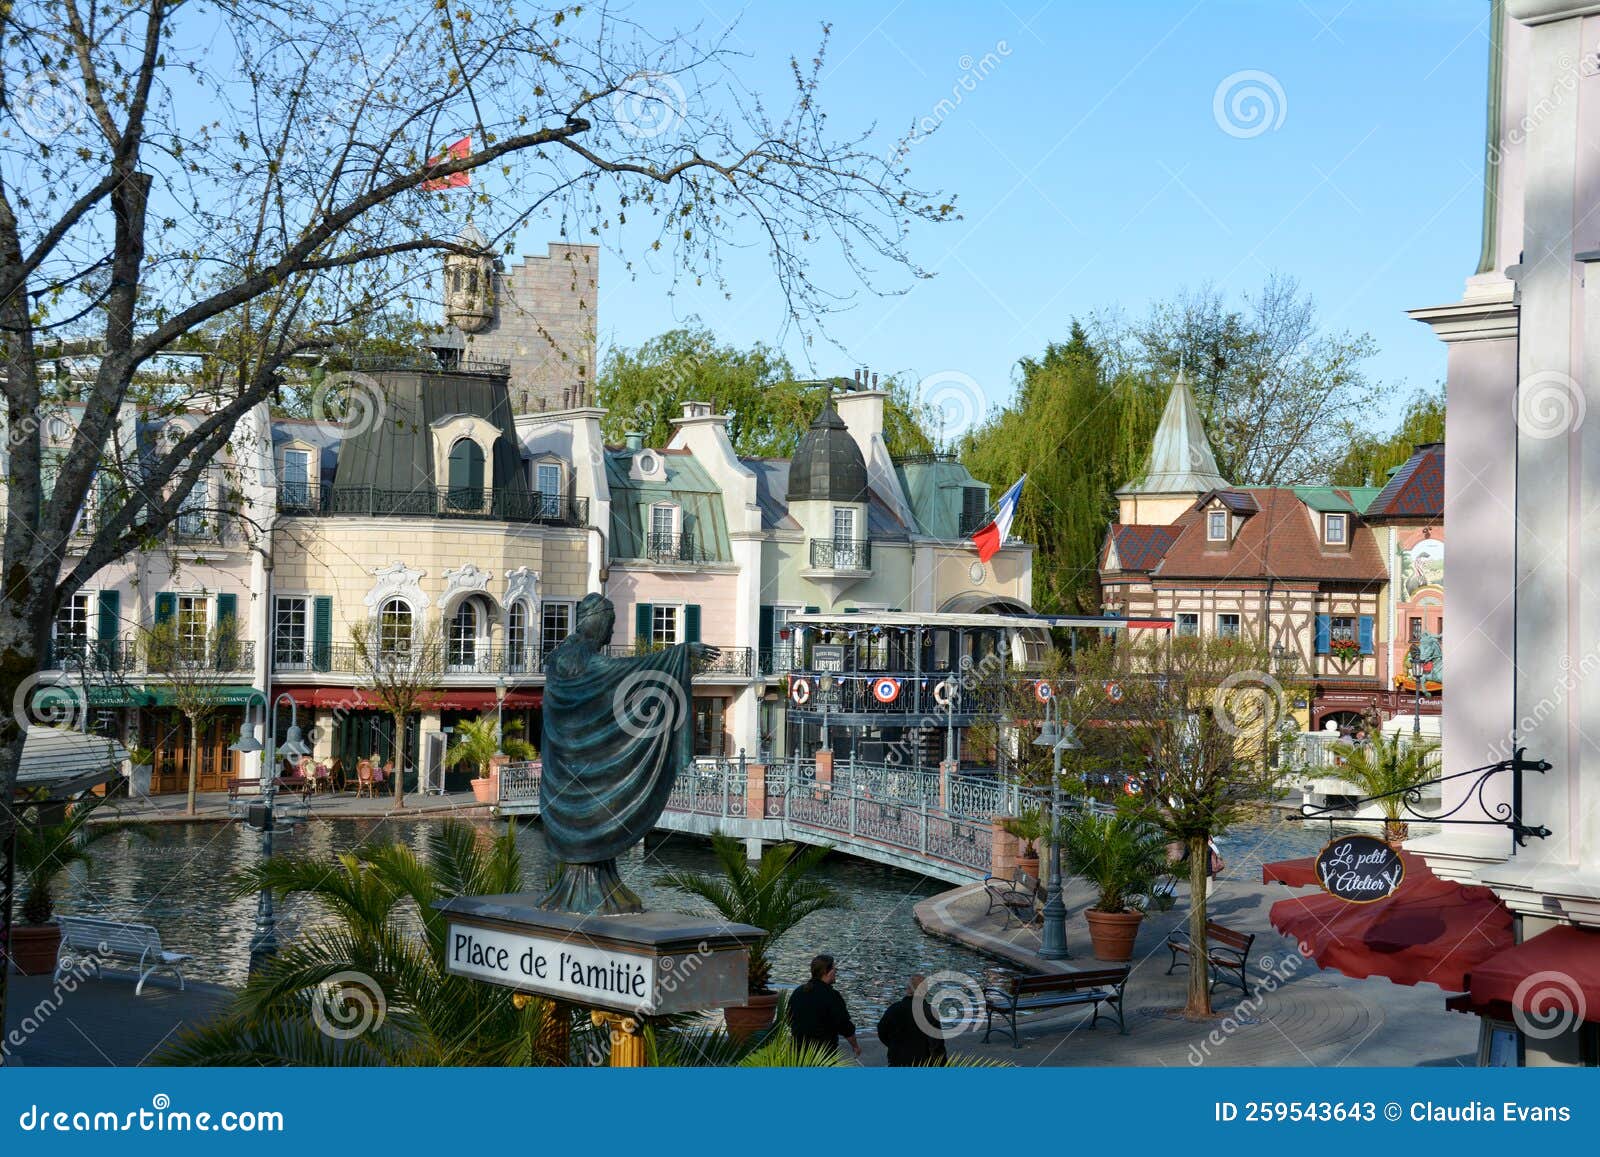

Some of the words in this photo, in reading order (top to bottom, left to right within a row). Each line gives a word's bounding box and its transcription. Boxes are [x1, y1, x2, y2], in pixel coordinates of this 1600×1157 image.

[1329, 843, 1353, 870] Le
[1354, 848, 1388, 870] petit
[455, 933, 509, 972] Place
[520, 946, 548, 980] de
[559, 953, 646, 998] l'amitié
